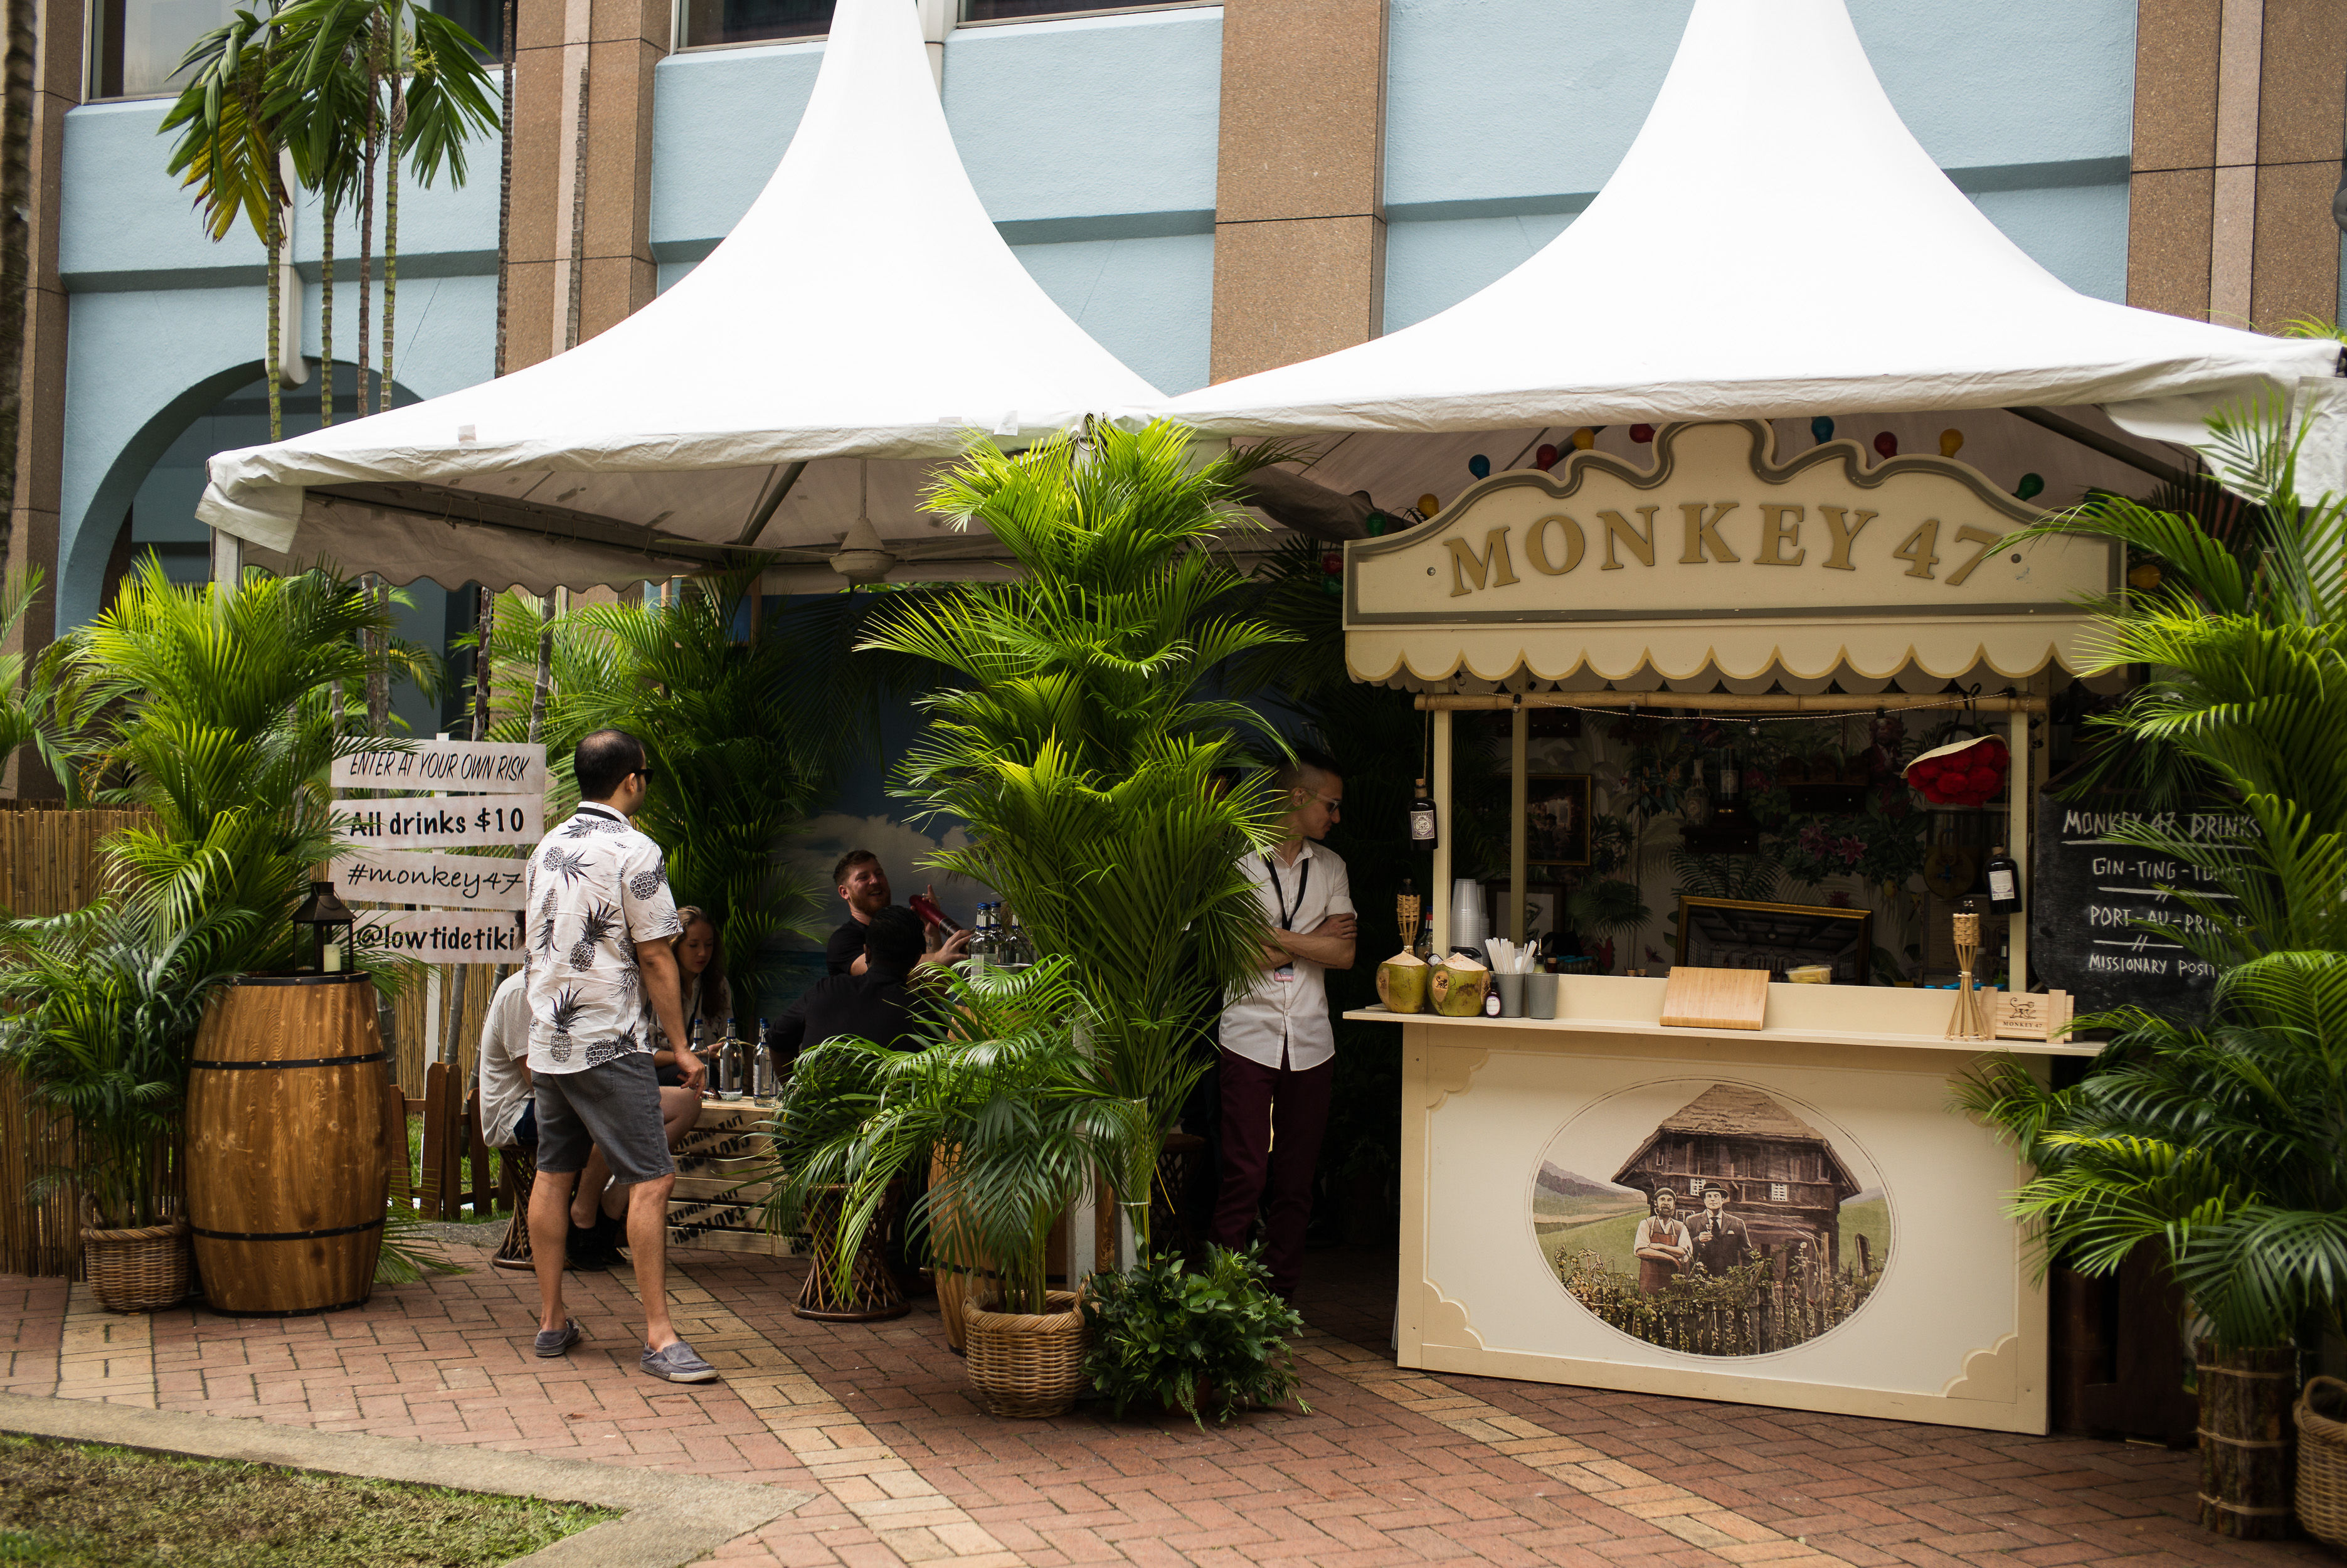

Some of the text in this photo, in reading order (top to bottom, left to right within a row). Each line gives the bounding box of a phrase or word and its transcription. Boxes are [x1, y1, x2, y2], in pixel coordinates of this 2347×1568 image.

[1441, 501, 2001, 598] MONKEY 47
[349, 750, 531, 781] ENTER AT YOUR OWN RISK
[349, 807, 525, 837] All drinks $10
[2062, 810, 2262, 839] MONKEY 47 DRINKS
[347, 863, 524, 899] #monkey47
[355, 923, 515, 951] @lowtidetiki
[2089, 954, 2168, 975] MISSIONARY
[677, 1126, 716, 1150] ANIMAL
